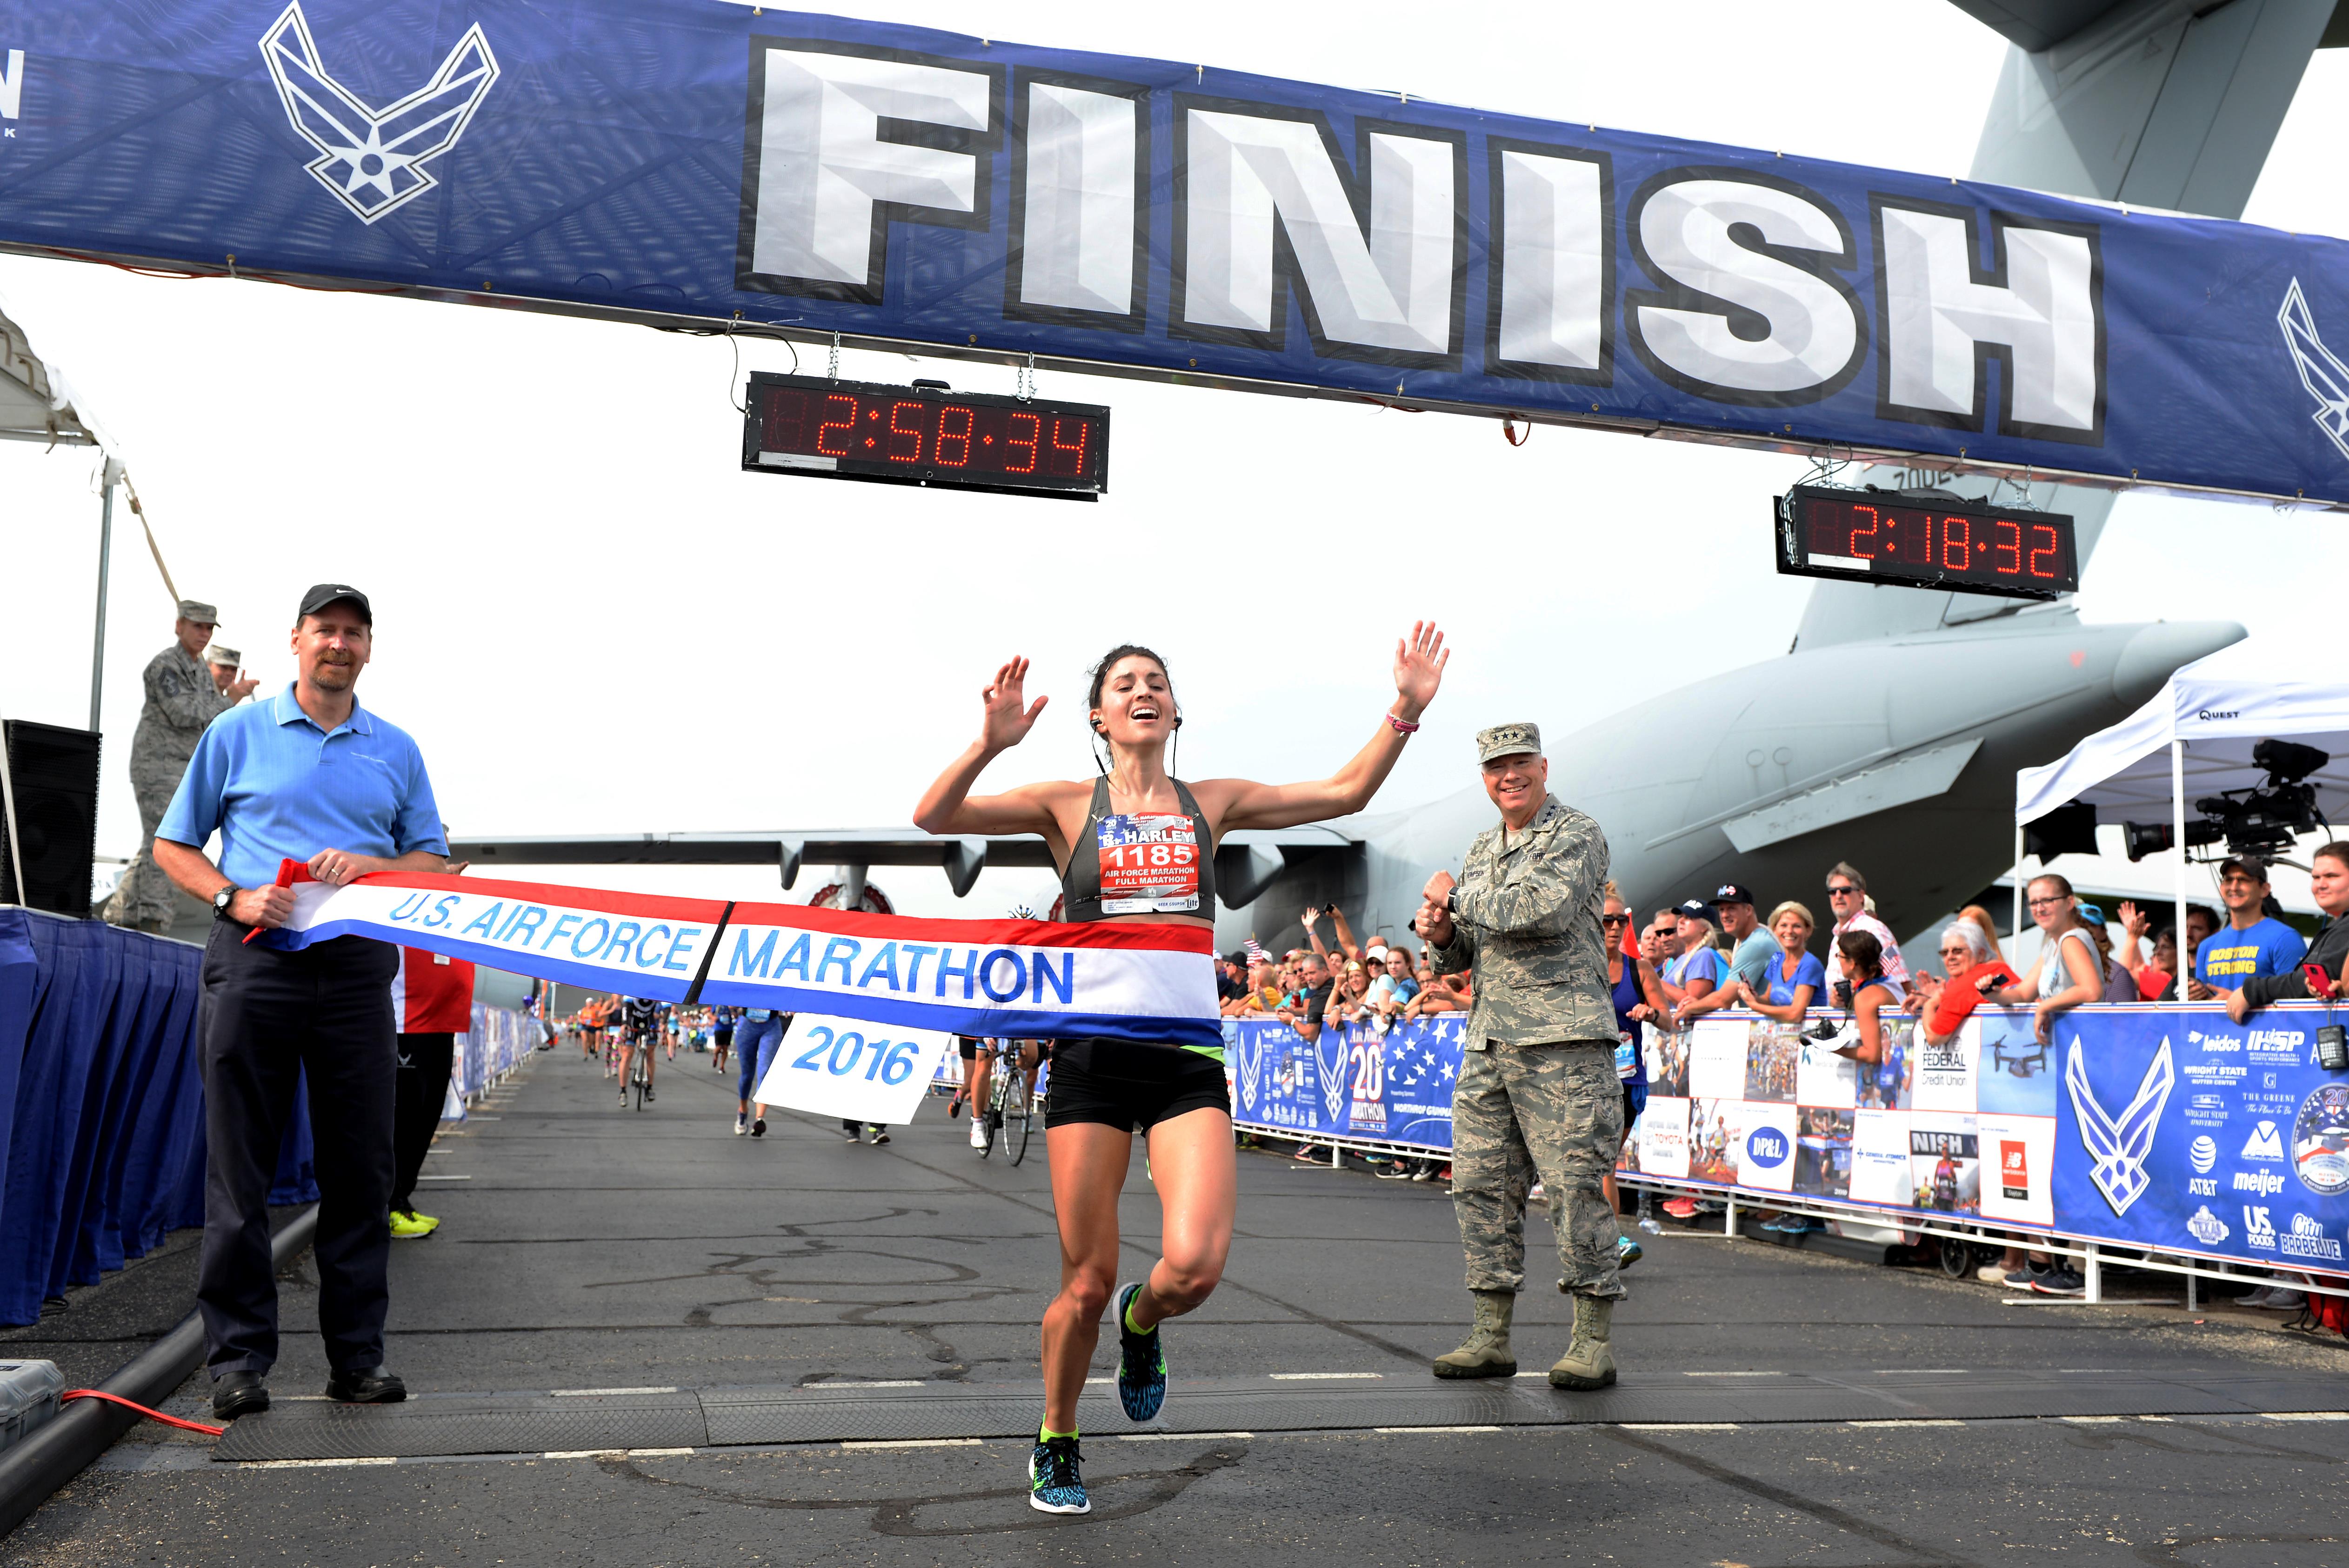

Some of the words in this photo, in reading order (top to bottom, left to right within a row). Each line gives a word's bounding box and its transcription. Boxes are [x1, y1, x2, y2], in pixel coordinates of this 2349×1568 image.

[750, 46, 2098, 434] FINISH
[2199, 710, 2240, 721] QUEST
[1124, 830, 1192, 843] HARLEY
[1109, 845, 1193, 867] 1185
[1529, 852, 1546, 861] FORC
[1105, 869, 1119, 877] AIR
[1121, 868, 1149, 876] FORCE
[1151, 867, 1195, 875] MARATHON
[1115, 877, 1138, 886] FULL
[1139, 875, 1187, 884] MARATHON
[389, 893, 461, 929] U.S.
[462, 902, 548, 946] AIR
[541, 914, 702, 971] FORCE
[2208, 946, 2260, 962] BOSTON
[727, 929, 1074, 1004] MARATHON
[2207, 960, 2256, 976] STRONG
[2202, 1035, 2241, 1052] leidos
[791, 1026, 920, 1085] 2016
[1923, 1053, 1966, 1067] FEDERAL
[1349, 1044, 1383, 1101] 20
[2184, 1066, 2218, 1075] WRIGHT
[2219, 1067, 2248, 1076] STATE
[1922, 1074, 1944, 1085] Credit
[1946, 1074, 1968, 1086] Union
[2243, 1092, 2260, 1101] THE
[2263, 1094, 2296, 1103] GREENE
[1655, 1133, 1683, 1146] TOYOTA
[1753, 1137, 1783, 1159] DP&L
[2189, 1178, 2218, 1197] AT&T
[2233, 1168, 2285, 1197] meijer
[2247, 1233, 2276, 1248] FOODS
